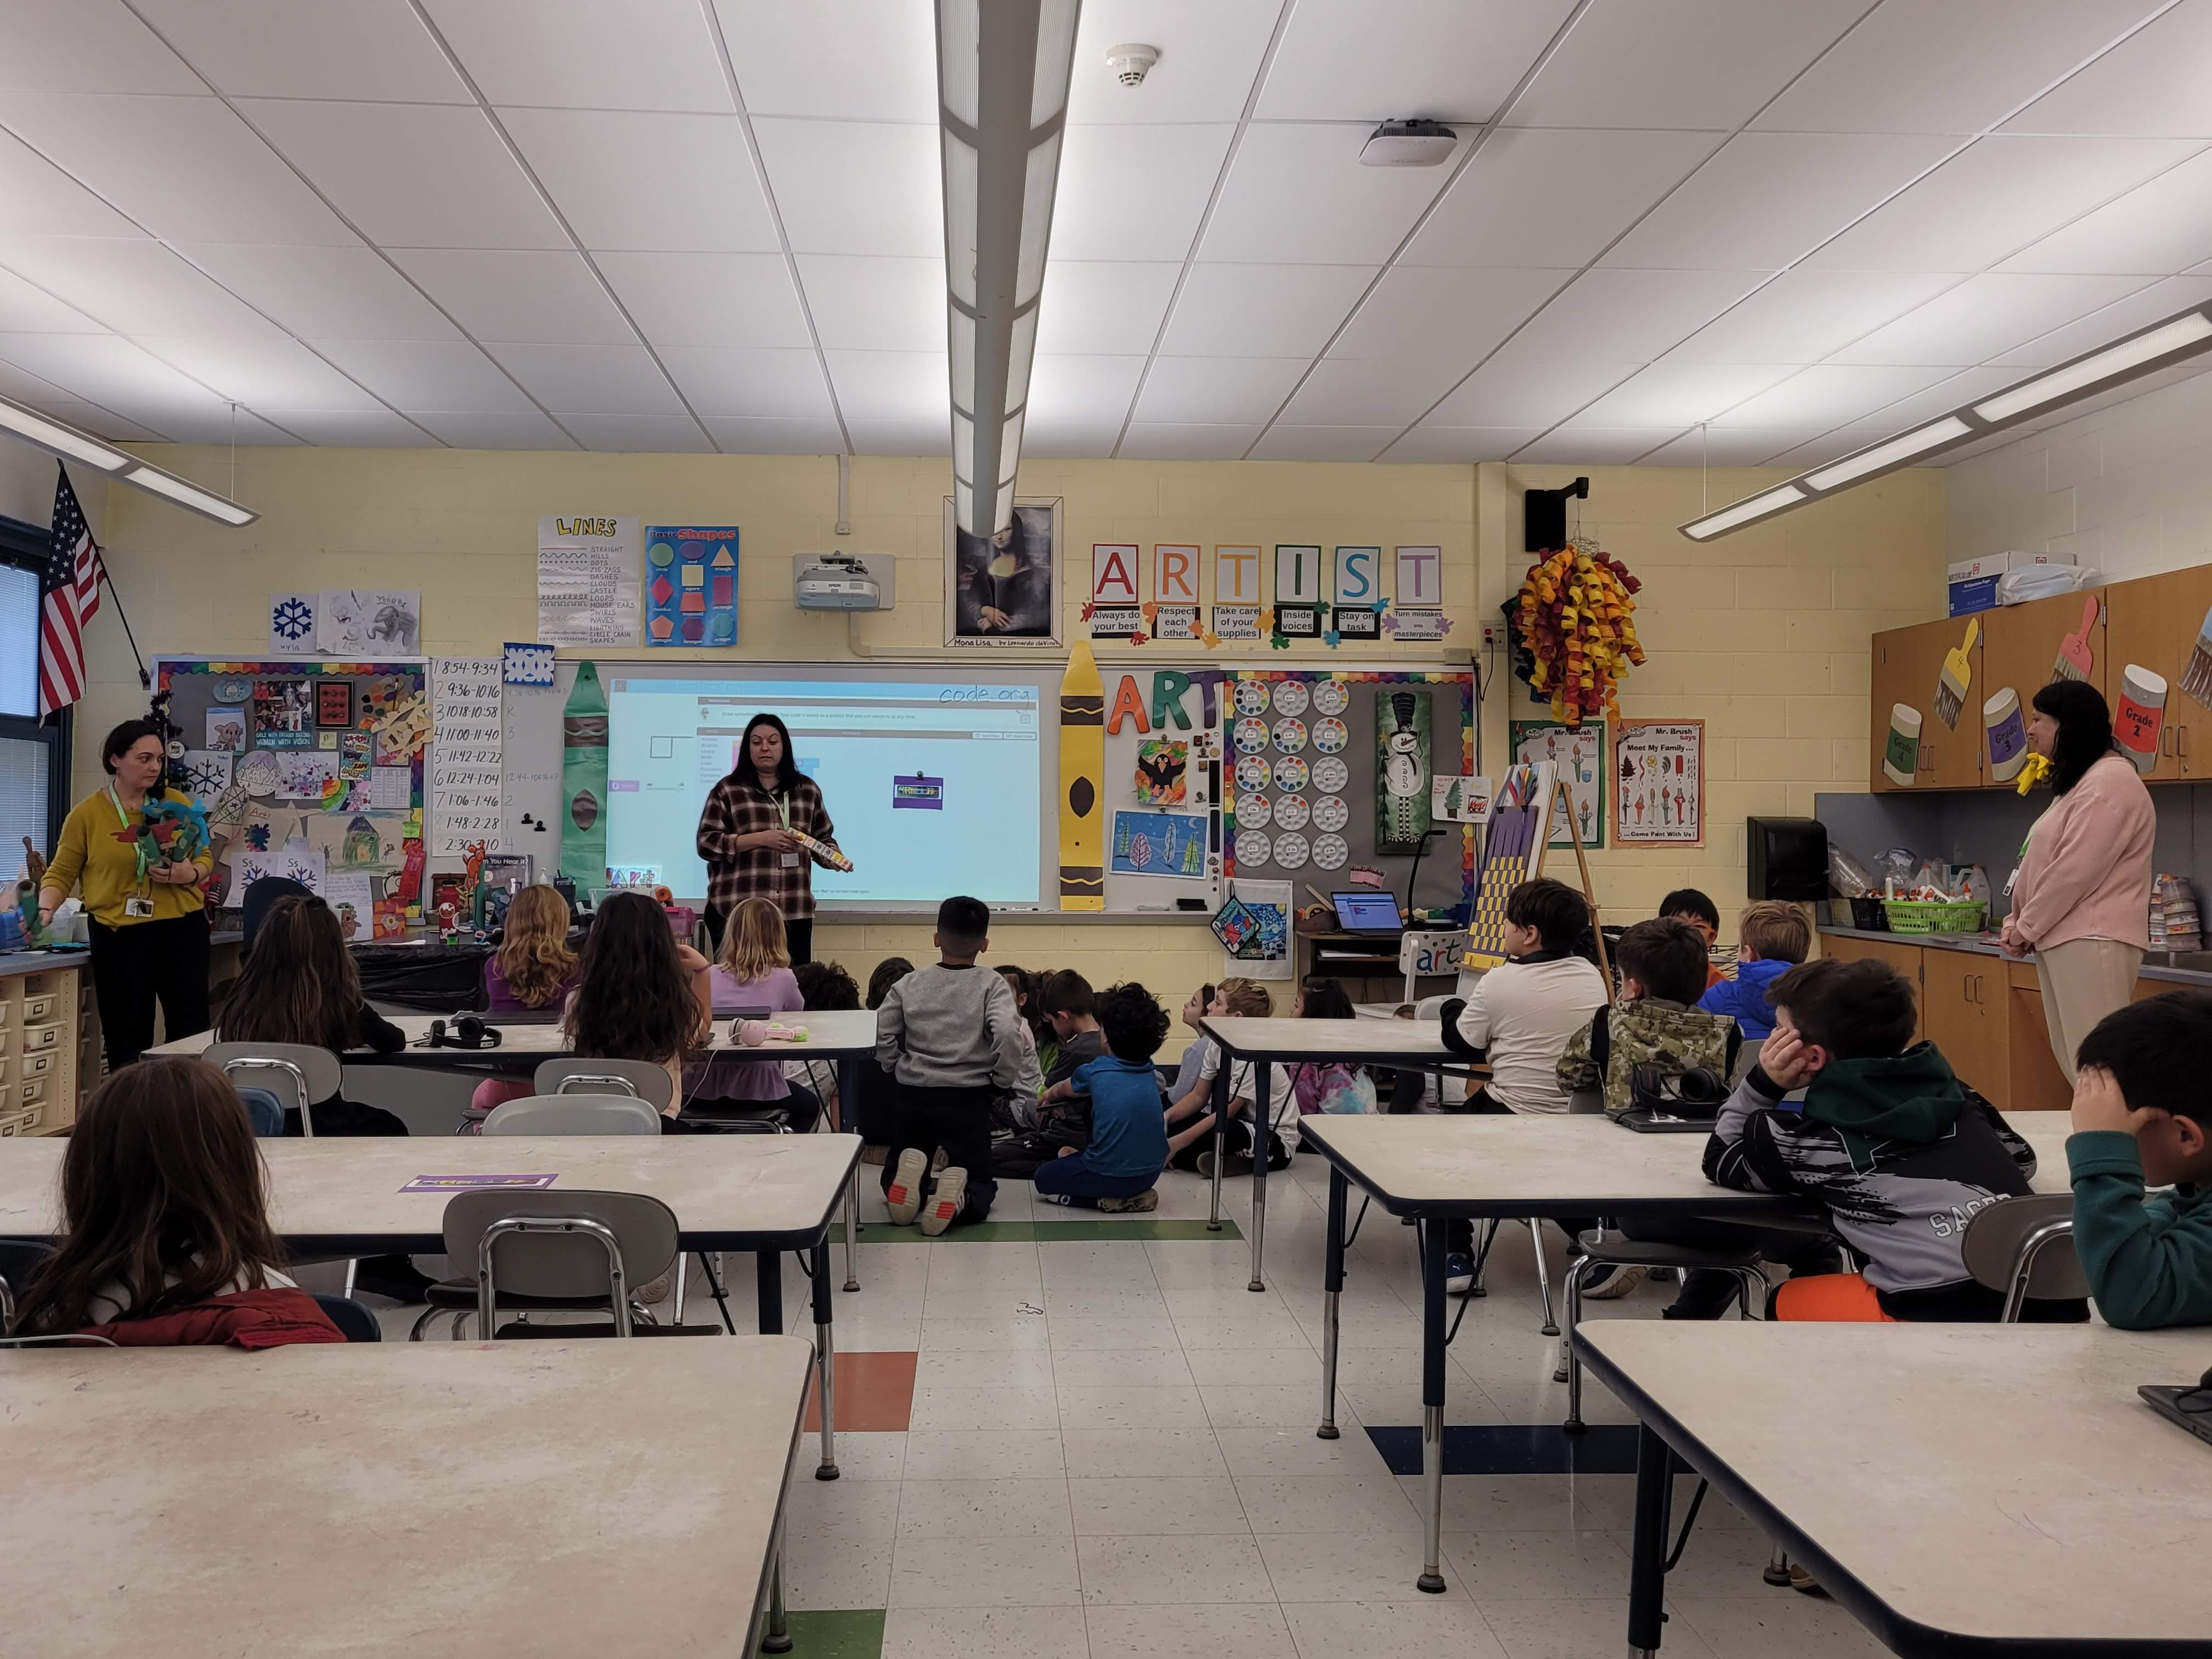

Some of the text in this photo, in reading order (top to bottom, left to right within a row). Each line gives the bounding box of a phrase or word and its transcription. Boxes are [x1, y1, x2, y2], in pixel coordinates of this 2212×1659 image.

[556, 518, 617, 537] LINES
[678, 529, 736, 540] Shapes
[1092, 612, 1125, 620] Always
[1158, 607, 1195, 616] Respect
[1284, 611, 1311, 619] Inside
[1340, 612, 1359, 622] Stay
[1094, 622, 1138, 632] your best
[1165, 618, 1187, 626] each
[1233, 619, 1254, 628] your
[1283, 622, 1313, 630] voices
[1347, 623, 1367, 631] task
[1217, 629, 1256, 638] supplies
[1394, 630, 1442, 639] masterpieces
[2073, 640, 2083, 654] 3
[434, 661, 498, 676] 1 8:54-9:34
[1957, 656, 1963, 669] 4
[434, 681, 500, 699] 2 9:36-10:16
[939, 685, 1030, 713] code.org
[1107, 670, 1226, 735] ART
[436, 704, 498, 722] 3 10:18-10:58
[506, 706, 516, 717] K
[2126, 707, 2153, 728] Grade
[434, 726, 499, 744] 4 11:00-11:40
[507, 726, 515, 740] 3
[1995, 724, 2018, 744] Grade
[2132, 725, 2140, 737] 2
[1894, 737, 1912, 754] Grade
[2004, 740, 2011, 752] 3
[435, 748, 502, 764] 5 11:42-12:22
[1898, 752, 1904, 763] 4
[434, 769, 499, 786] 6 12:24-1:04
[434, 791, 499, 809] 7 1:06-1:46
[504, 795, 514, 807] 2
[446, 815, 500, 830] 1:48-2:28
[505, 837, 514, 853] 4
[242, 859, 253, 867] Ss
[287, 859, 298, 867] Ss
[1417, 938, 1461, 972] art
